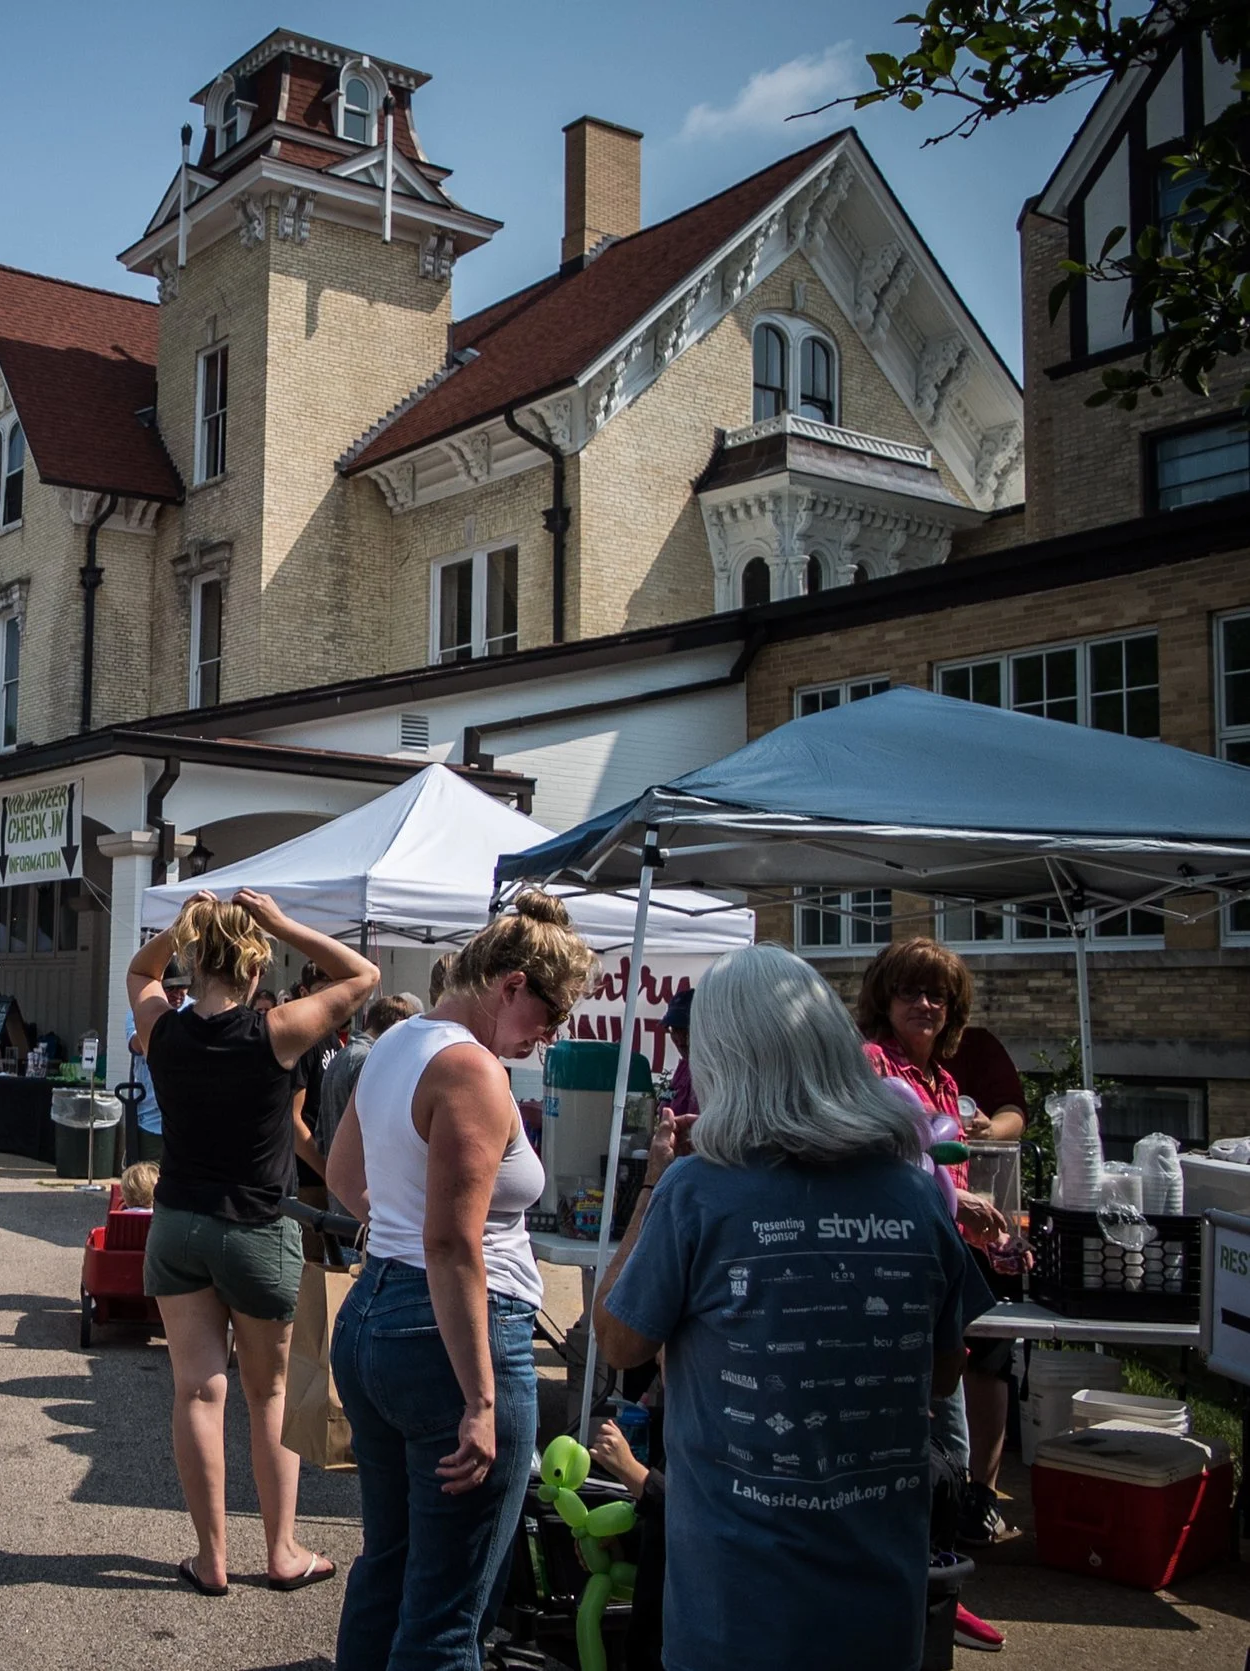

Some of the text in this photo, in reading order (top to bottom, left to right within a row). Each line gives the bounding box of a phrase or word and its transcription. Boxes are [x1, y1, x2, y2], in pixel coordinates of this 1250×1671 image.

[7, 785, 68, 816] VOLUNTEER
[9, 850, 61, 874] INFORMATION
[752, 1217, 805, 1232] Presenting
[818, 1213, 915, 1243] stryker
[758, 1231, 798, 1246] Sponsor
[1220, 1245, 1250, 1276] RES
[874, 1336, 893, 1347] bcu
[733, 1479, 887, 1510] LakesideArtsPark.org
